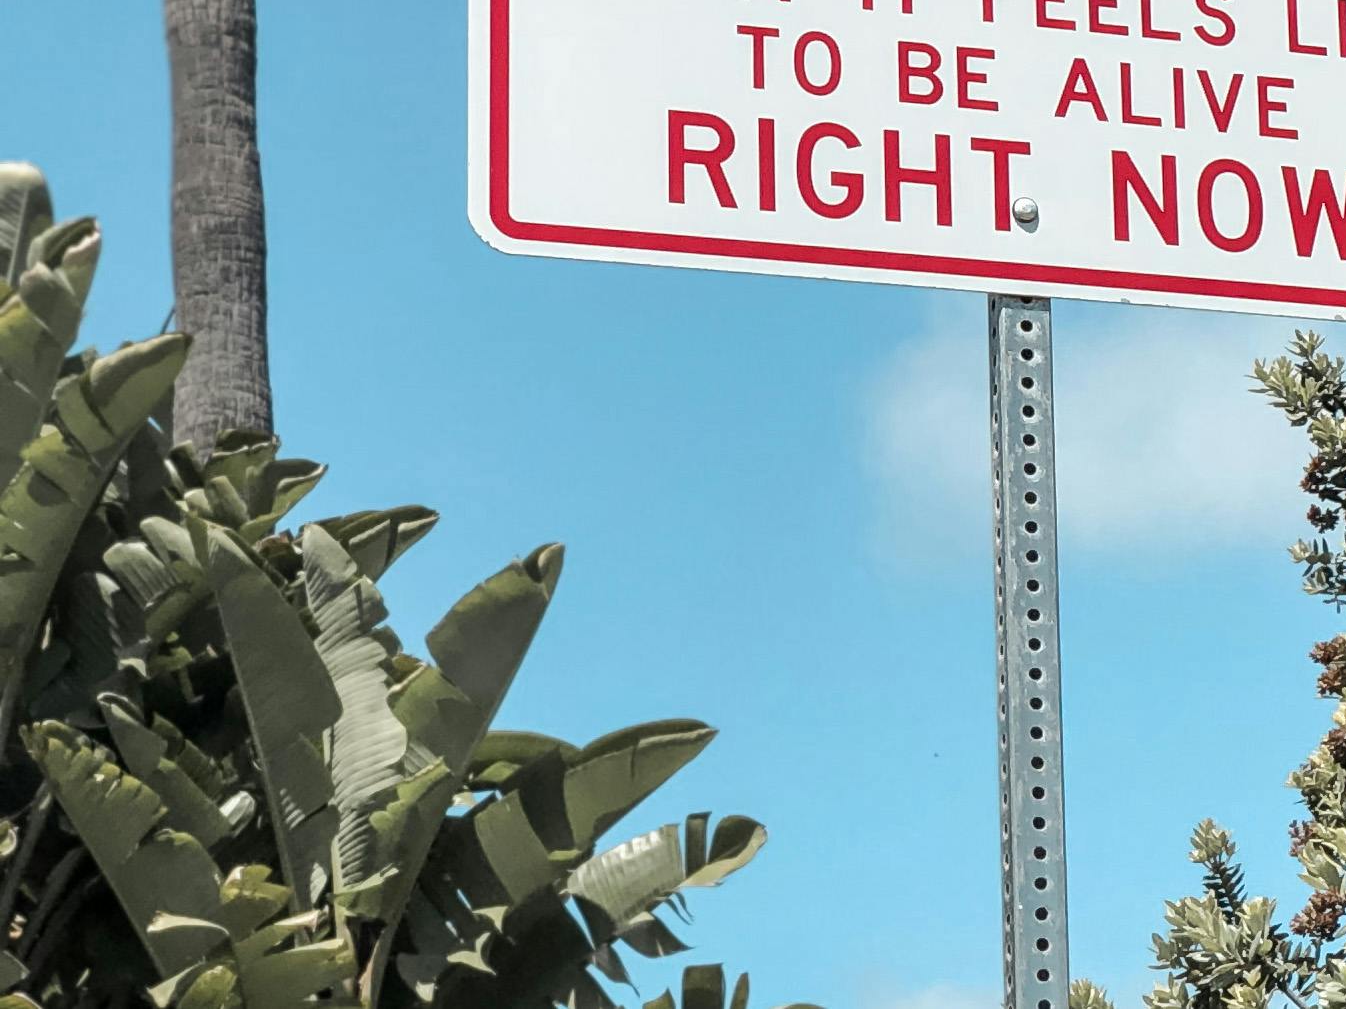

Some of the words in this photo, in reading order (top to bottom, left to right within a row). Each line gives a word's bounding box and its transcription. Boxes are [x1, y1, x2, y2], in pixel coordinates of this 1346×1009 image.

[736, 25, 842, 96] TO
[897, 41, 999, 111] BE
[1055, 58, 1299, 139] ALIVE
[667, 110, 1031, 231] RIGHT
